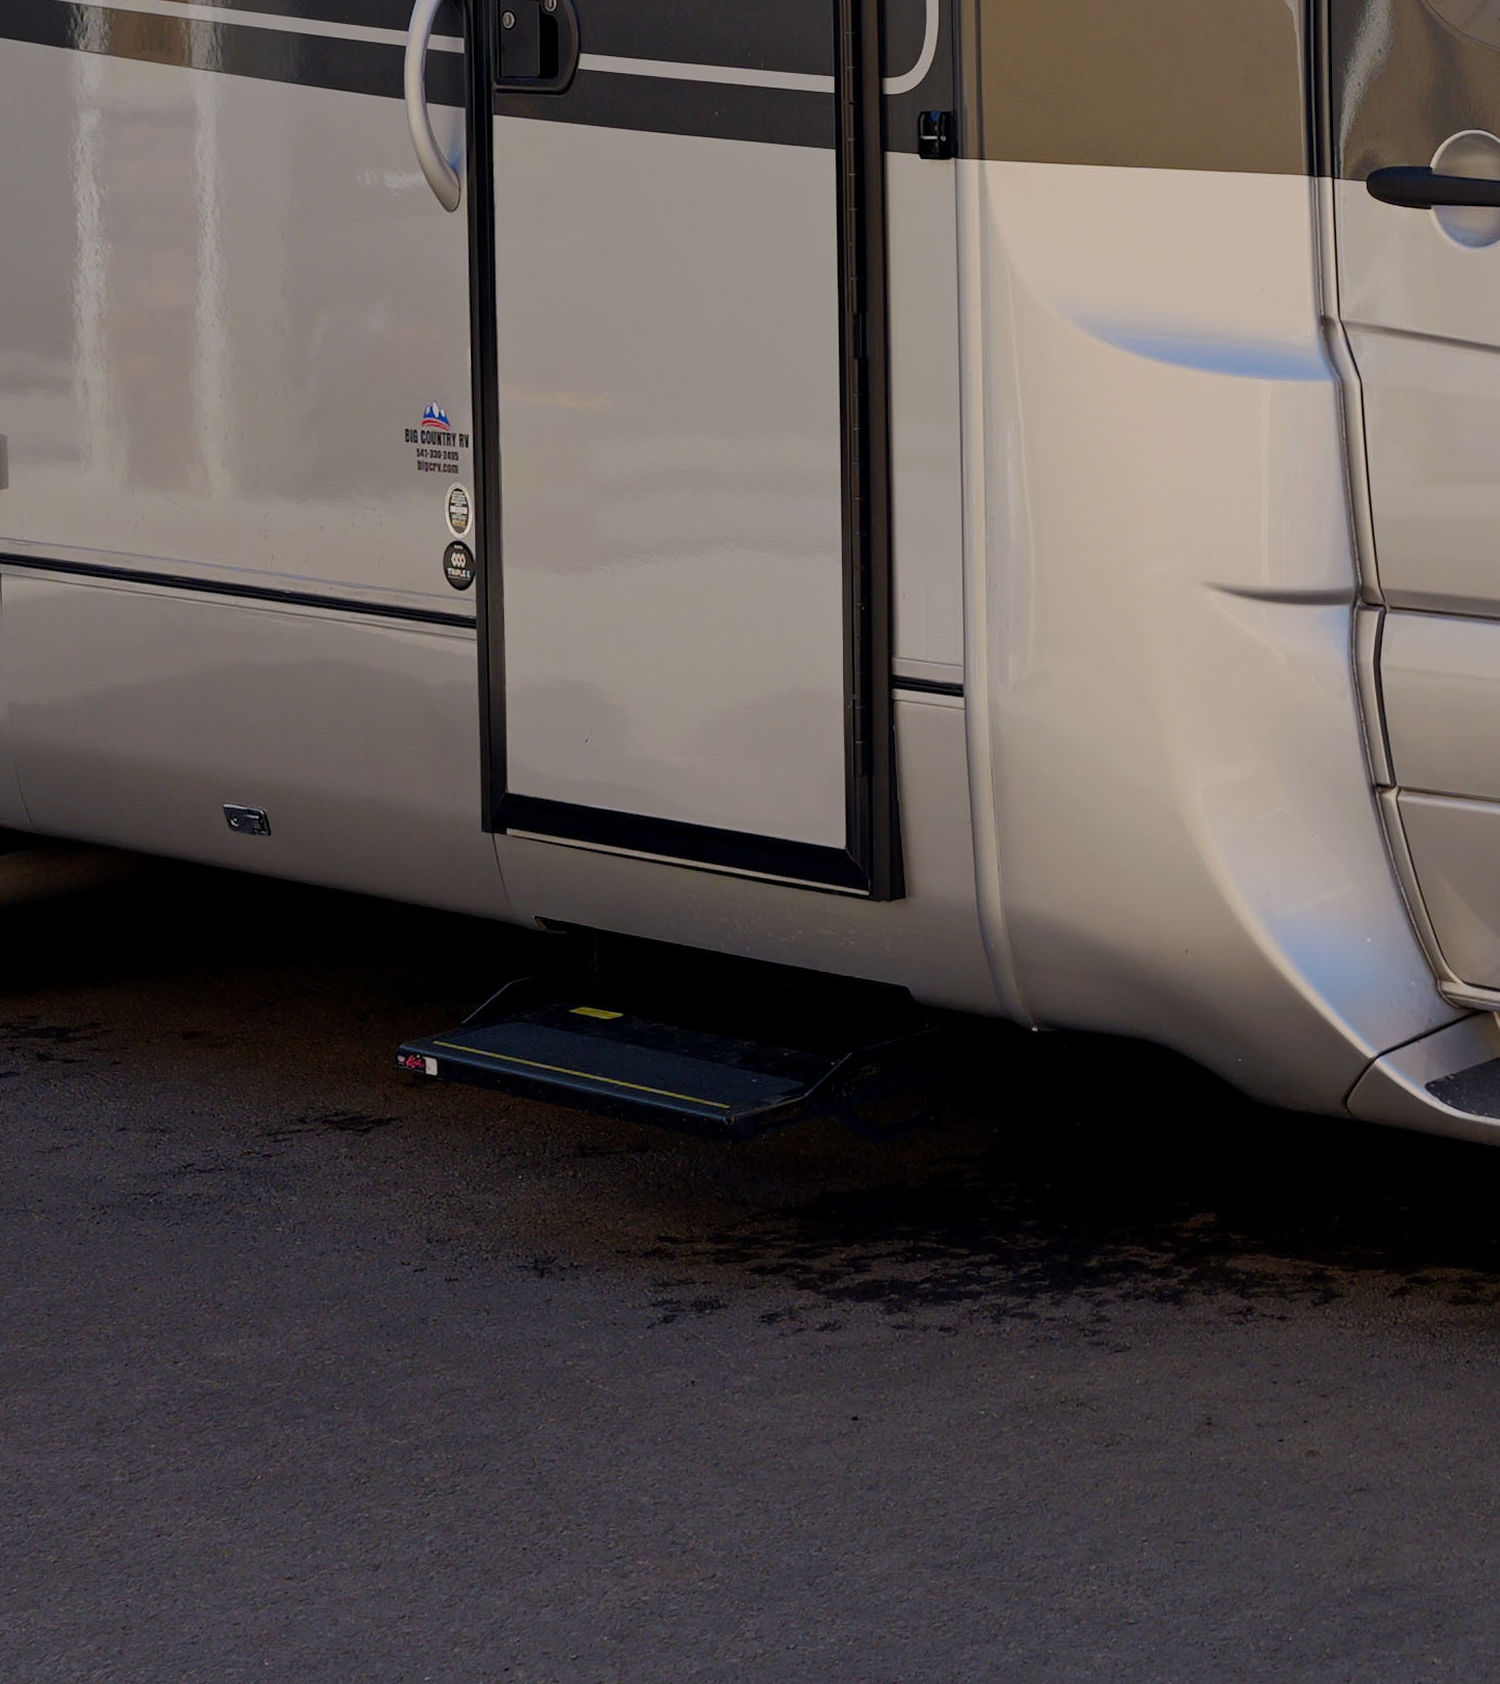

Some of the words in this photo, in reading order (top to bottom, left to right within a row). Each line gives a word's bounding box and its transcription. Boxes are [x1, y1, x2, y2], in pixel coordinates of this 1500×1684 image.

[404, 428, 419, 444] BIG
[420, 430, 457, 448] COUNTRY
[458, 433, 470, 449] RV
